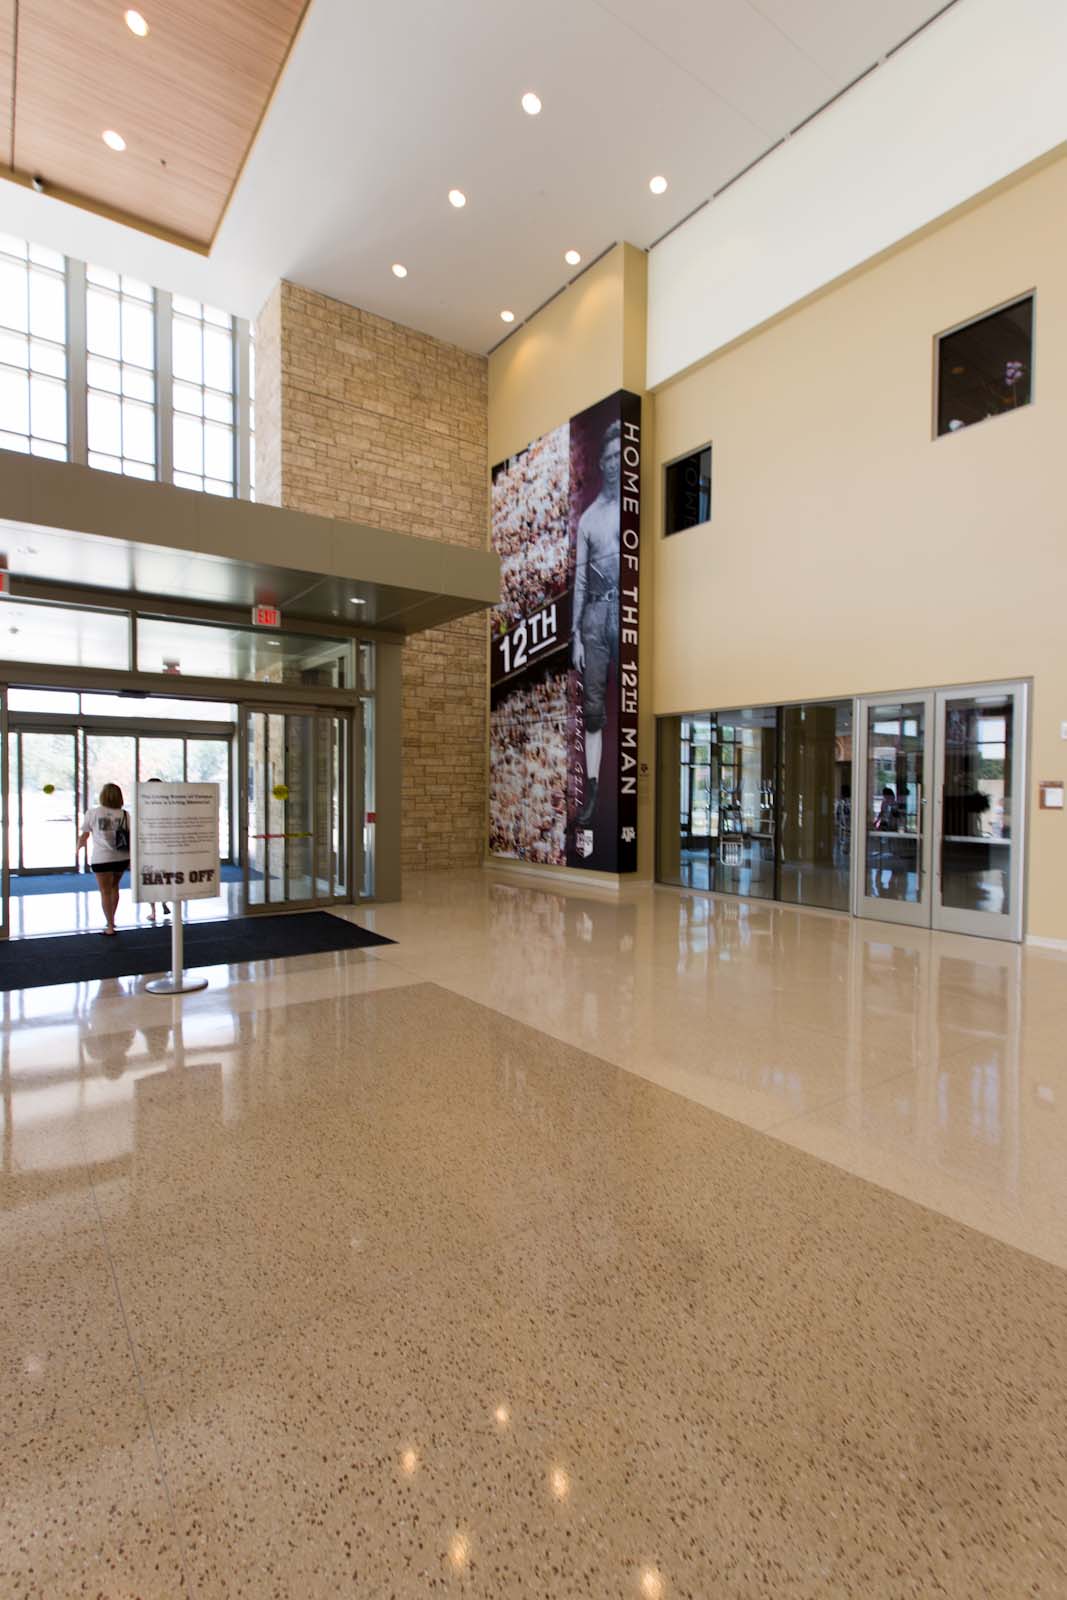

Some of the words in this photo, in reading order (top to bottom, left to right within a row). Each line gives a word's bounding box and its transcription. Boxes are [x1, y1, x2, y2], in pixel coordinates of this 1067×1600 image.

[623, 421, 640, 515] HOME
[623, 529, 639, 571] OF
[257, 608, 277, 625] EXIT
[499, 603, 557, 674] 12TH
[622, 586, 638, 646] THE
[621, 661, 638, 714] 12TH
[574, 704, 585, 754] KING
[574, 761, 585, 808] GILL
[621, 727, 637, 795] MAN
[141, 871, 185, 886] HATS
[188, 868, 215, 884] OFF
